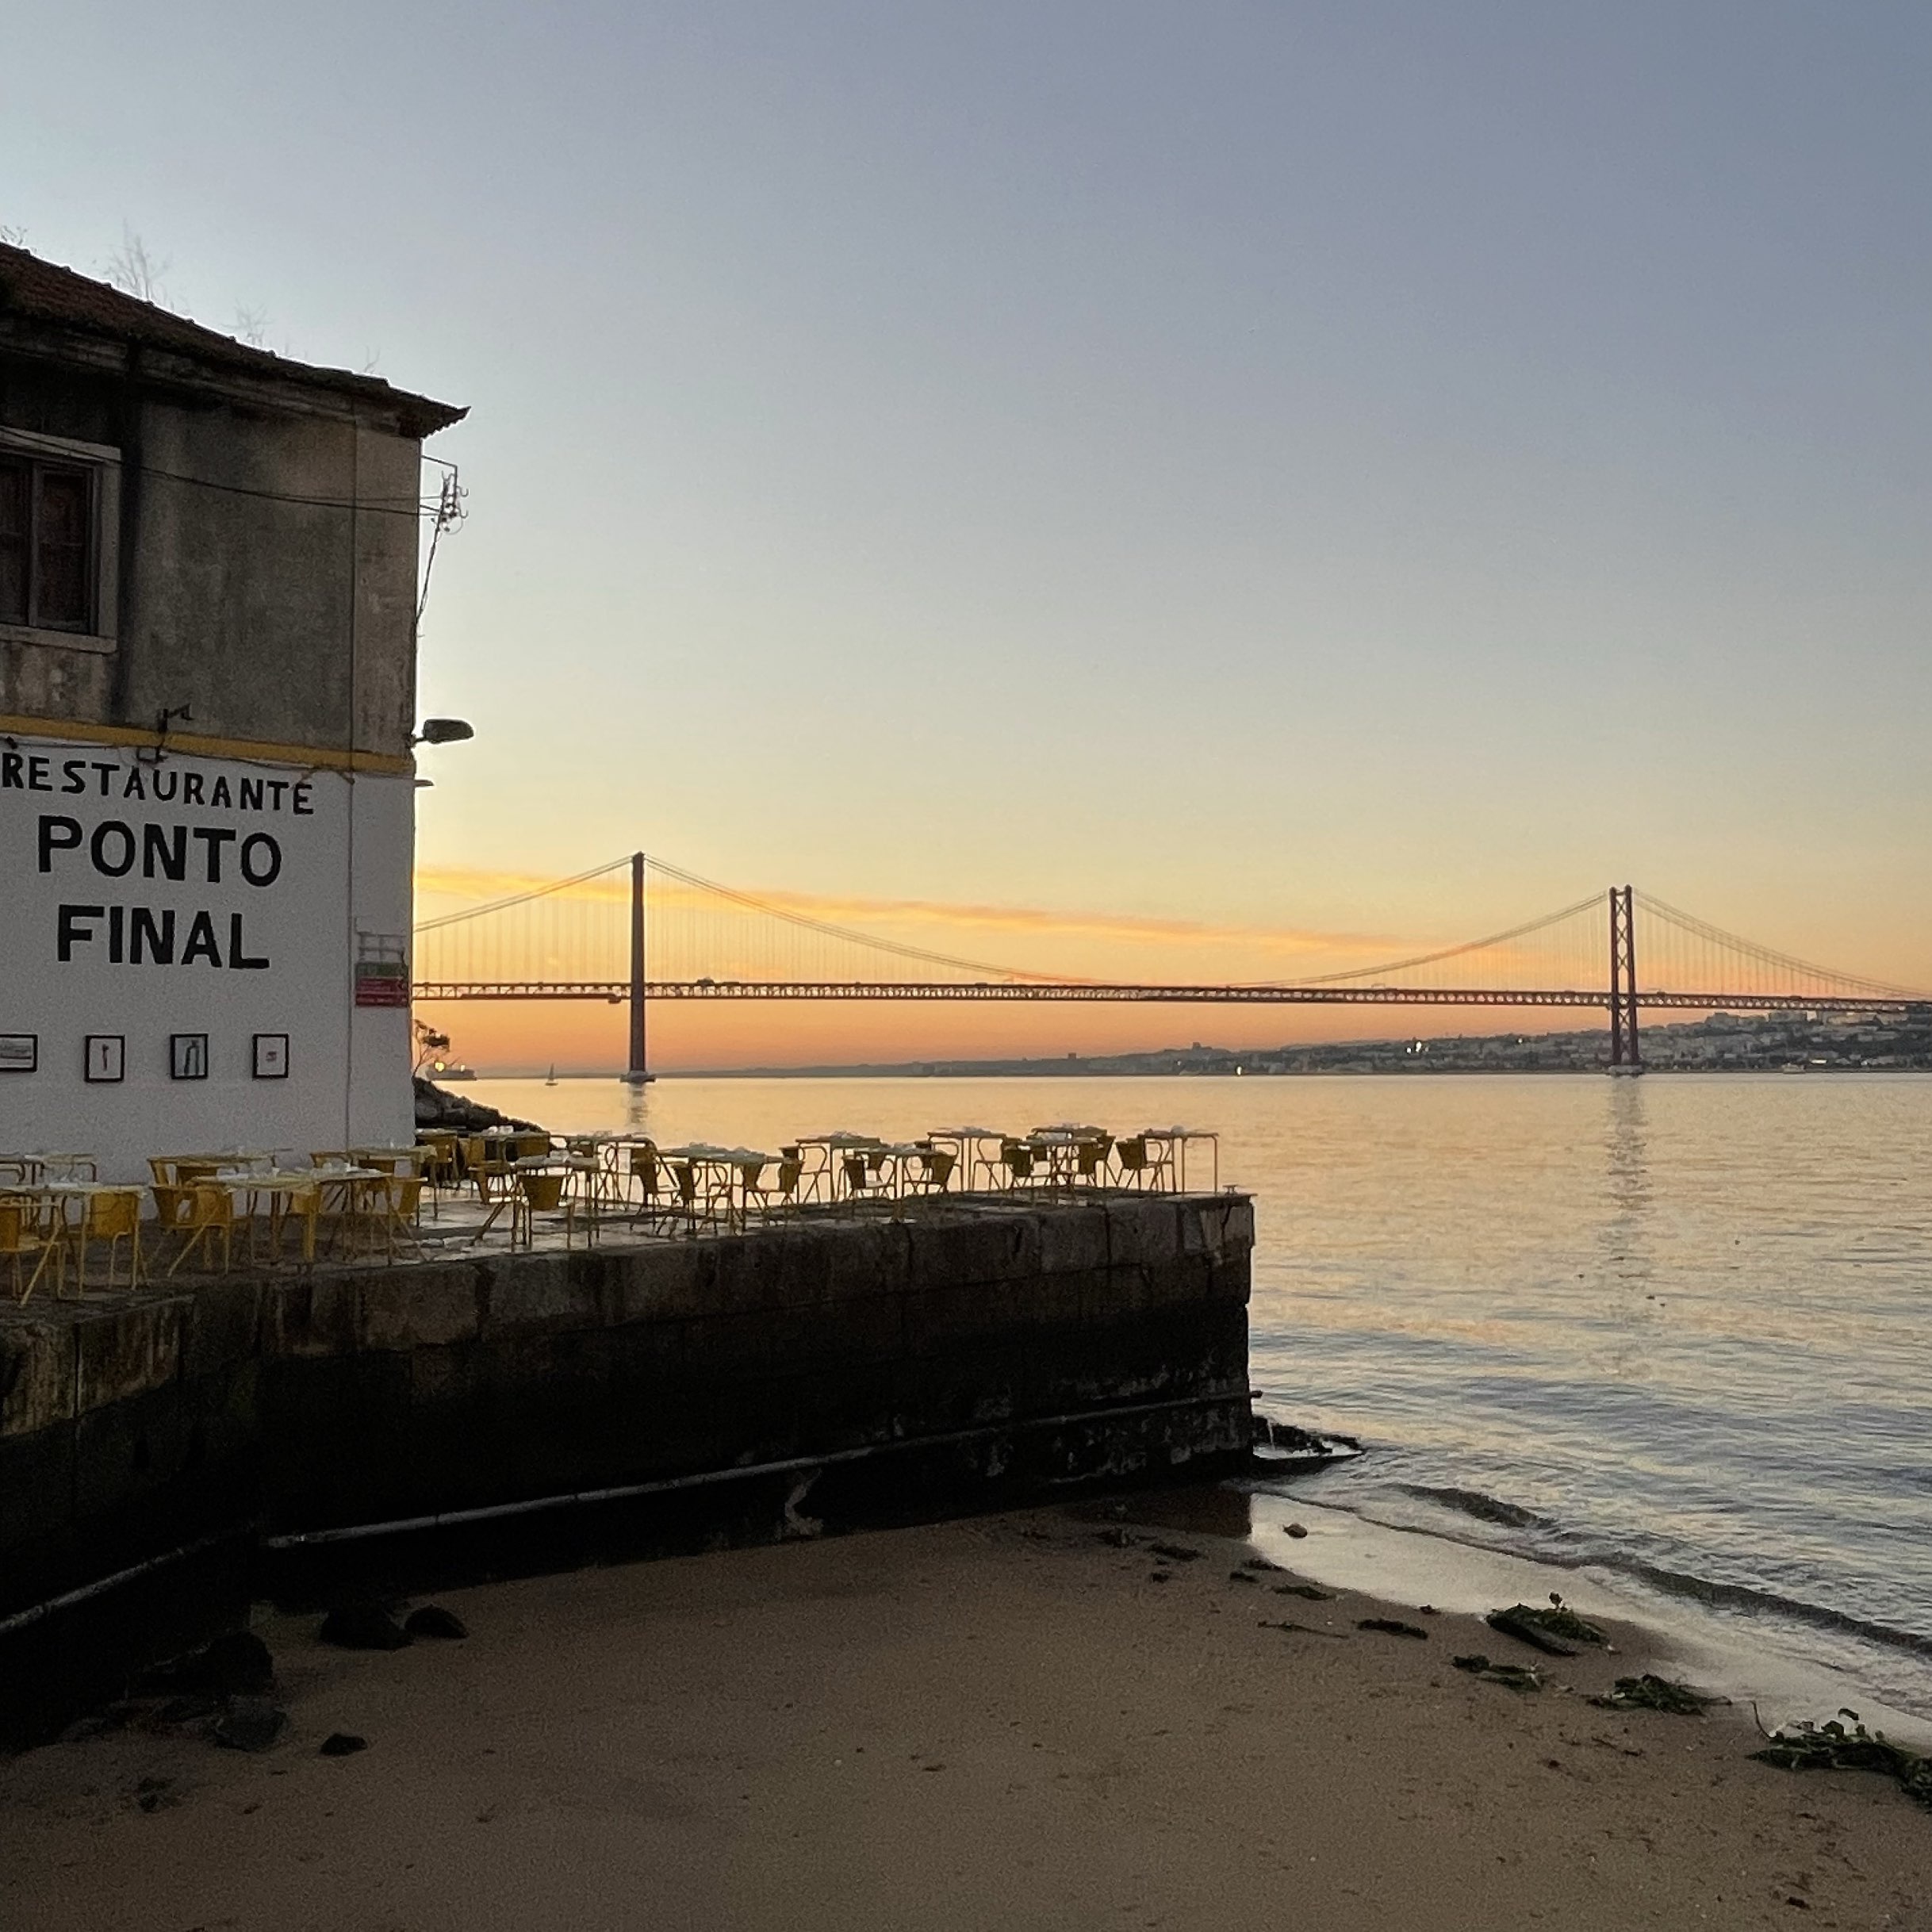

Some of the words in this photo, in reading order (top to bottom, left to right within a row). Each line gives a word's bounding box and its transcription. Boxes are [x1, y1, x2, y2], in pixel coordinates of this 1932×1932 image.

[2, 752, 314, 815] RESTAURANTE
[38, 815, 282, 887] PONTO
[57, 903, 270, 969] FINAL
